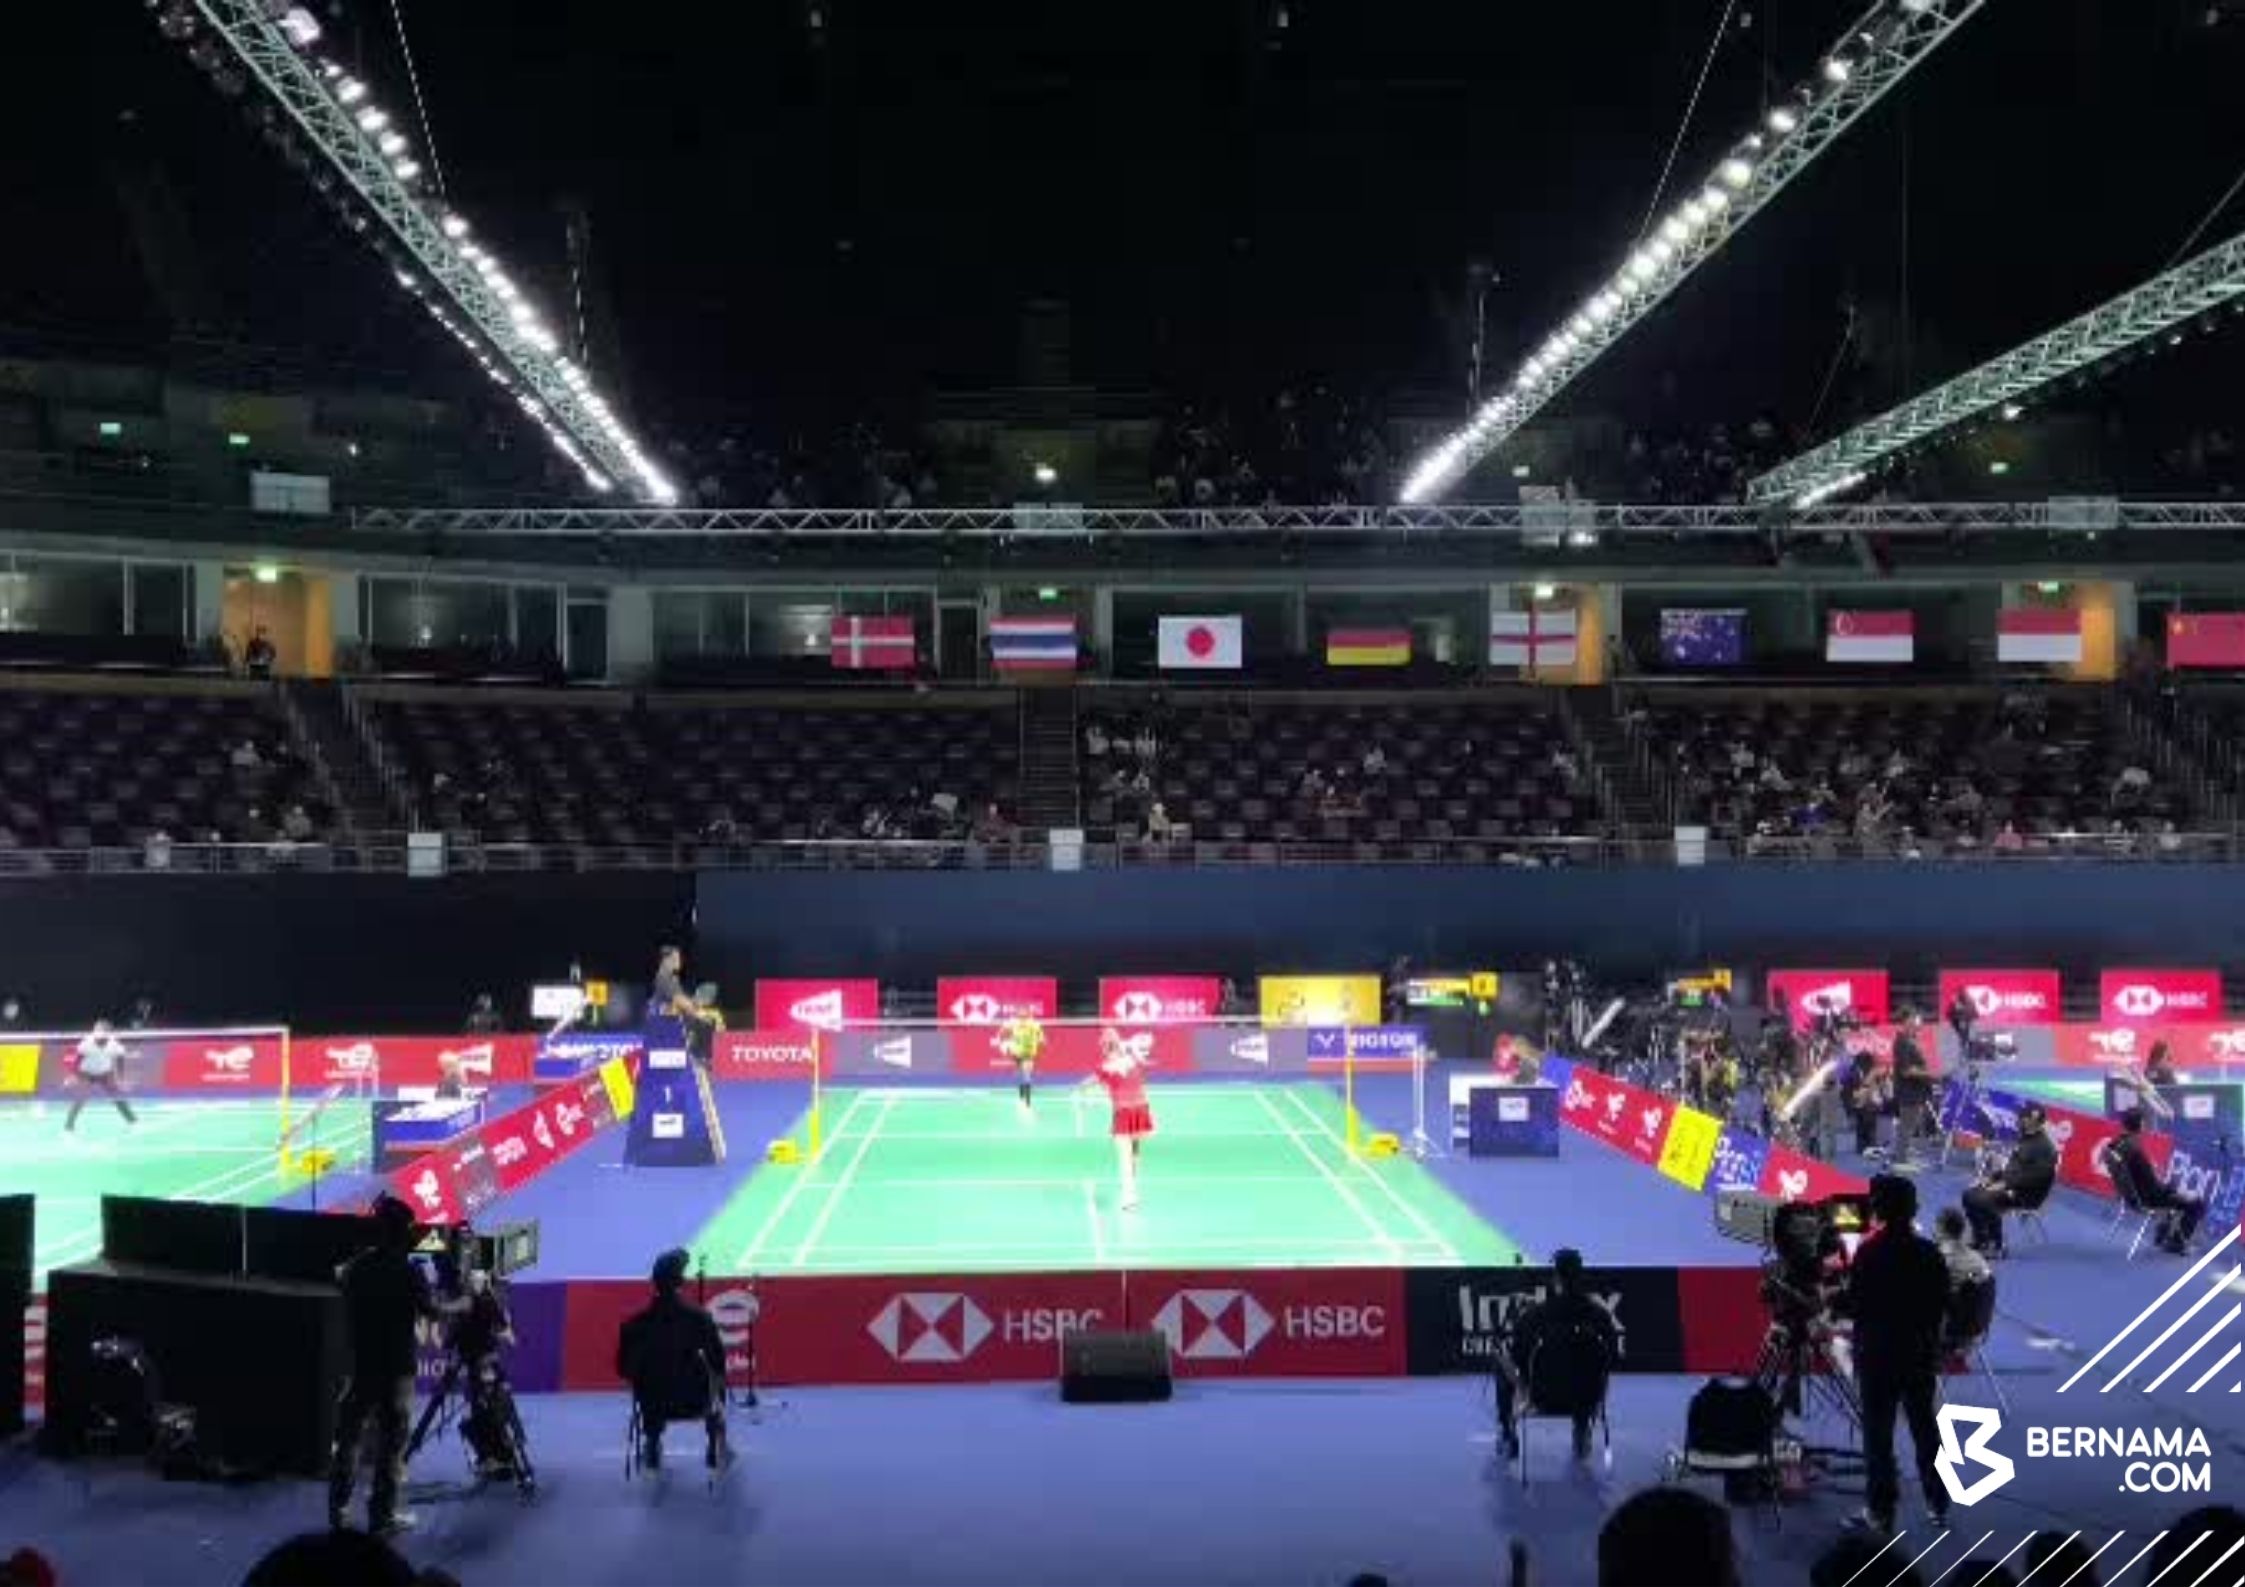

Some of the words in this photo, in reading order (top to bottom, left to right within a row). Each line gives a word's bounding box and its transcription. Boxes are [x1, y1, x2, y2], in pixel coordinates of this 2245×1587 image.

[731, 1044, 814, 1062] TOYOTA
[1284, 1305, 1386, 1338] HSBC
[1459, 1285, 1626, 1332] Inx
